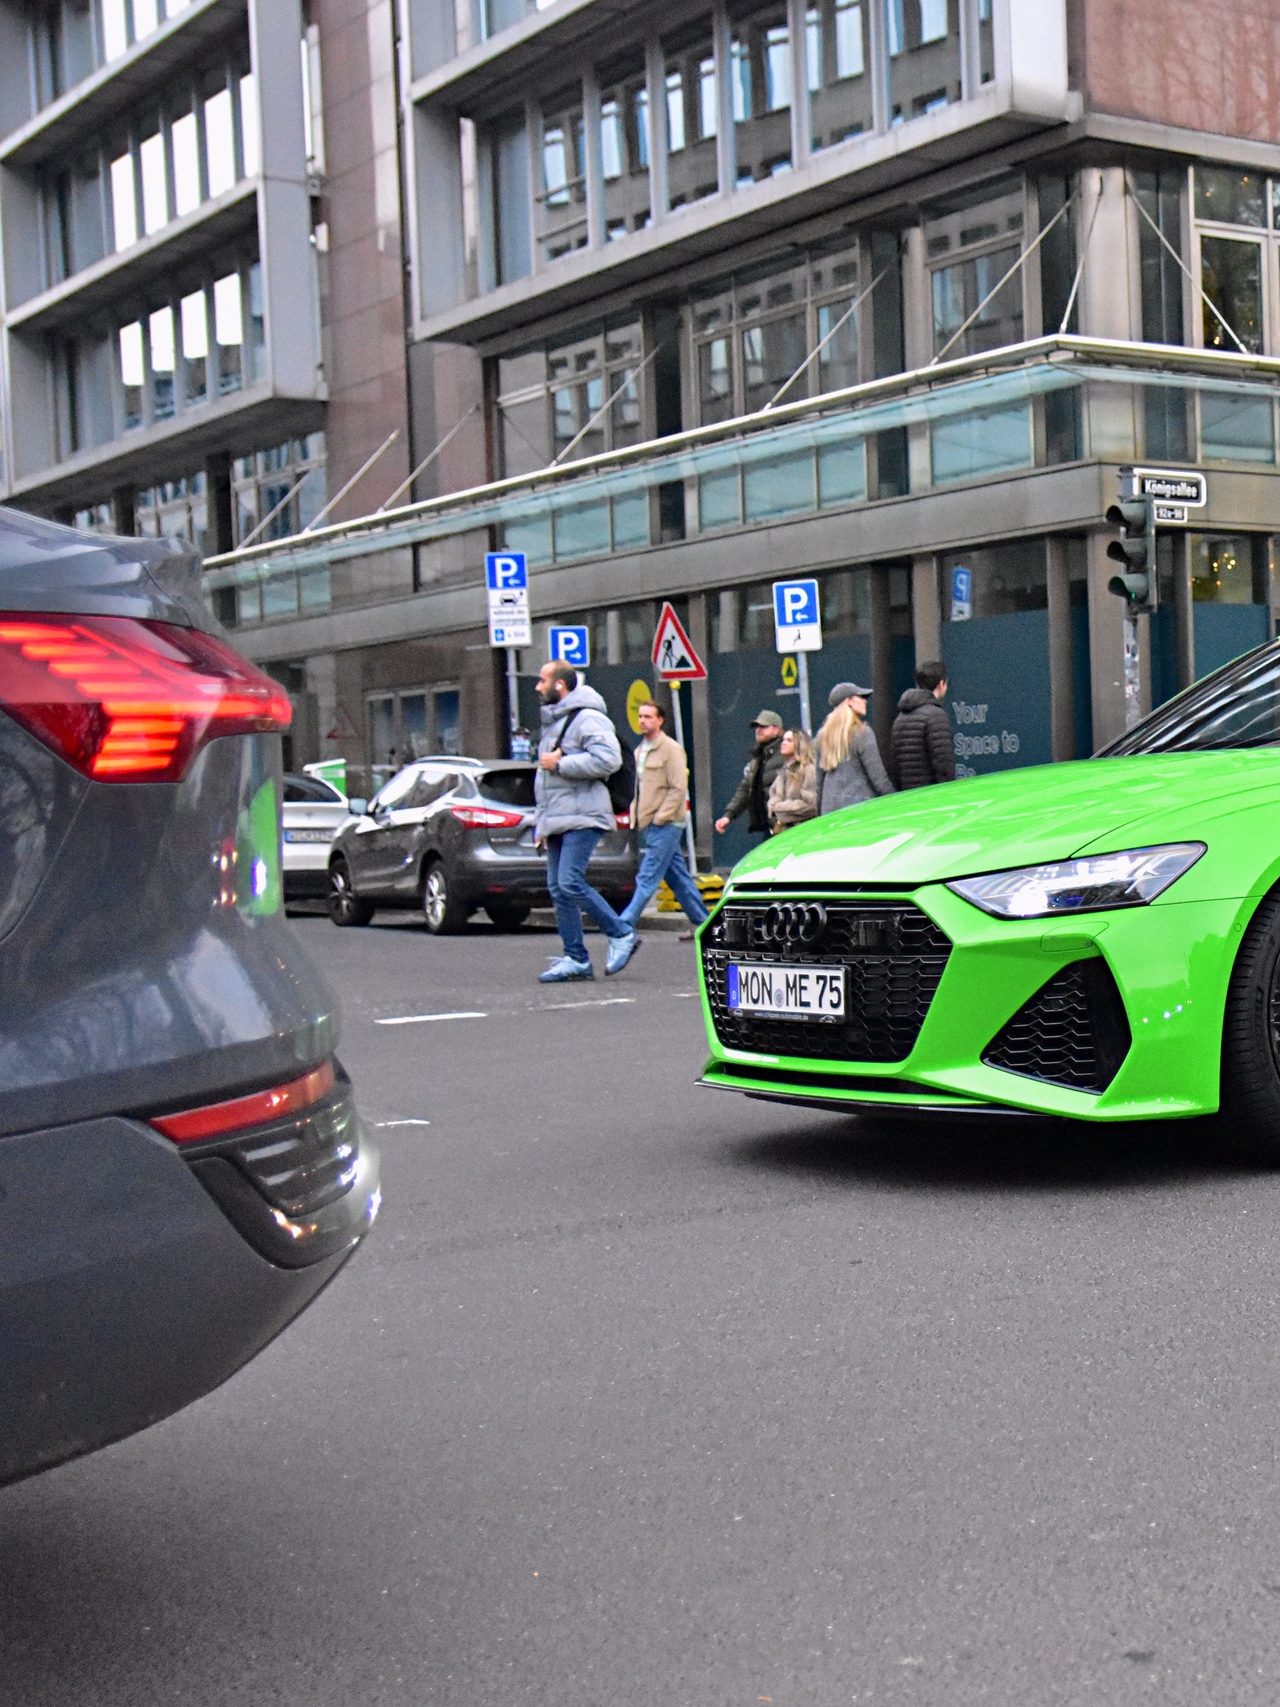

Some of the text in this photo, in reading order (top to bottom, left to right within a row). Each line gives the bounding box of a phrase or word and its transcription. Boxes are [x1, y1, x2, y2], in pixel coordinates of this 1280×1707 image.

[1144, 478, 1198, 498] Königsallee
[494, 557, 519, 588] P
[783, 587, 808, 623] P
[558, 631, 579, 660] P
[952, 701, 989, 724] Your
[953, 730, 1020, 760] Space to
[739, 970, 772, 1005] MON
[785, 973, 811, 1008] ME
[816, 974, 842, 1009] 75
